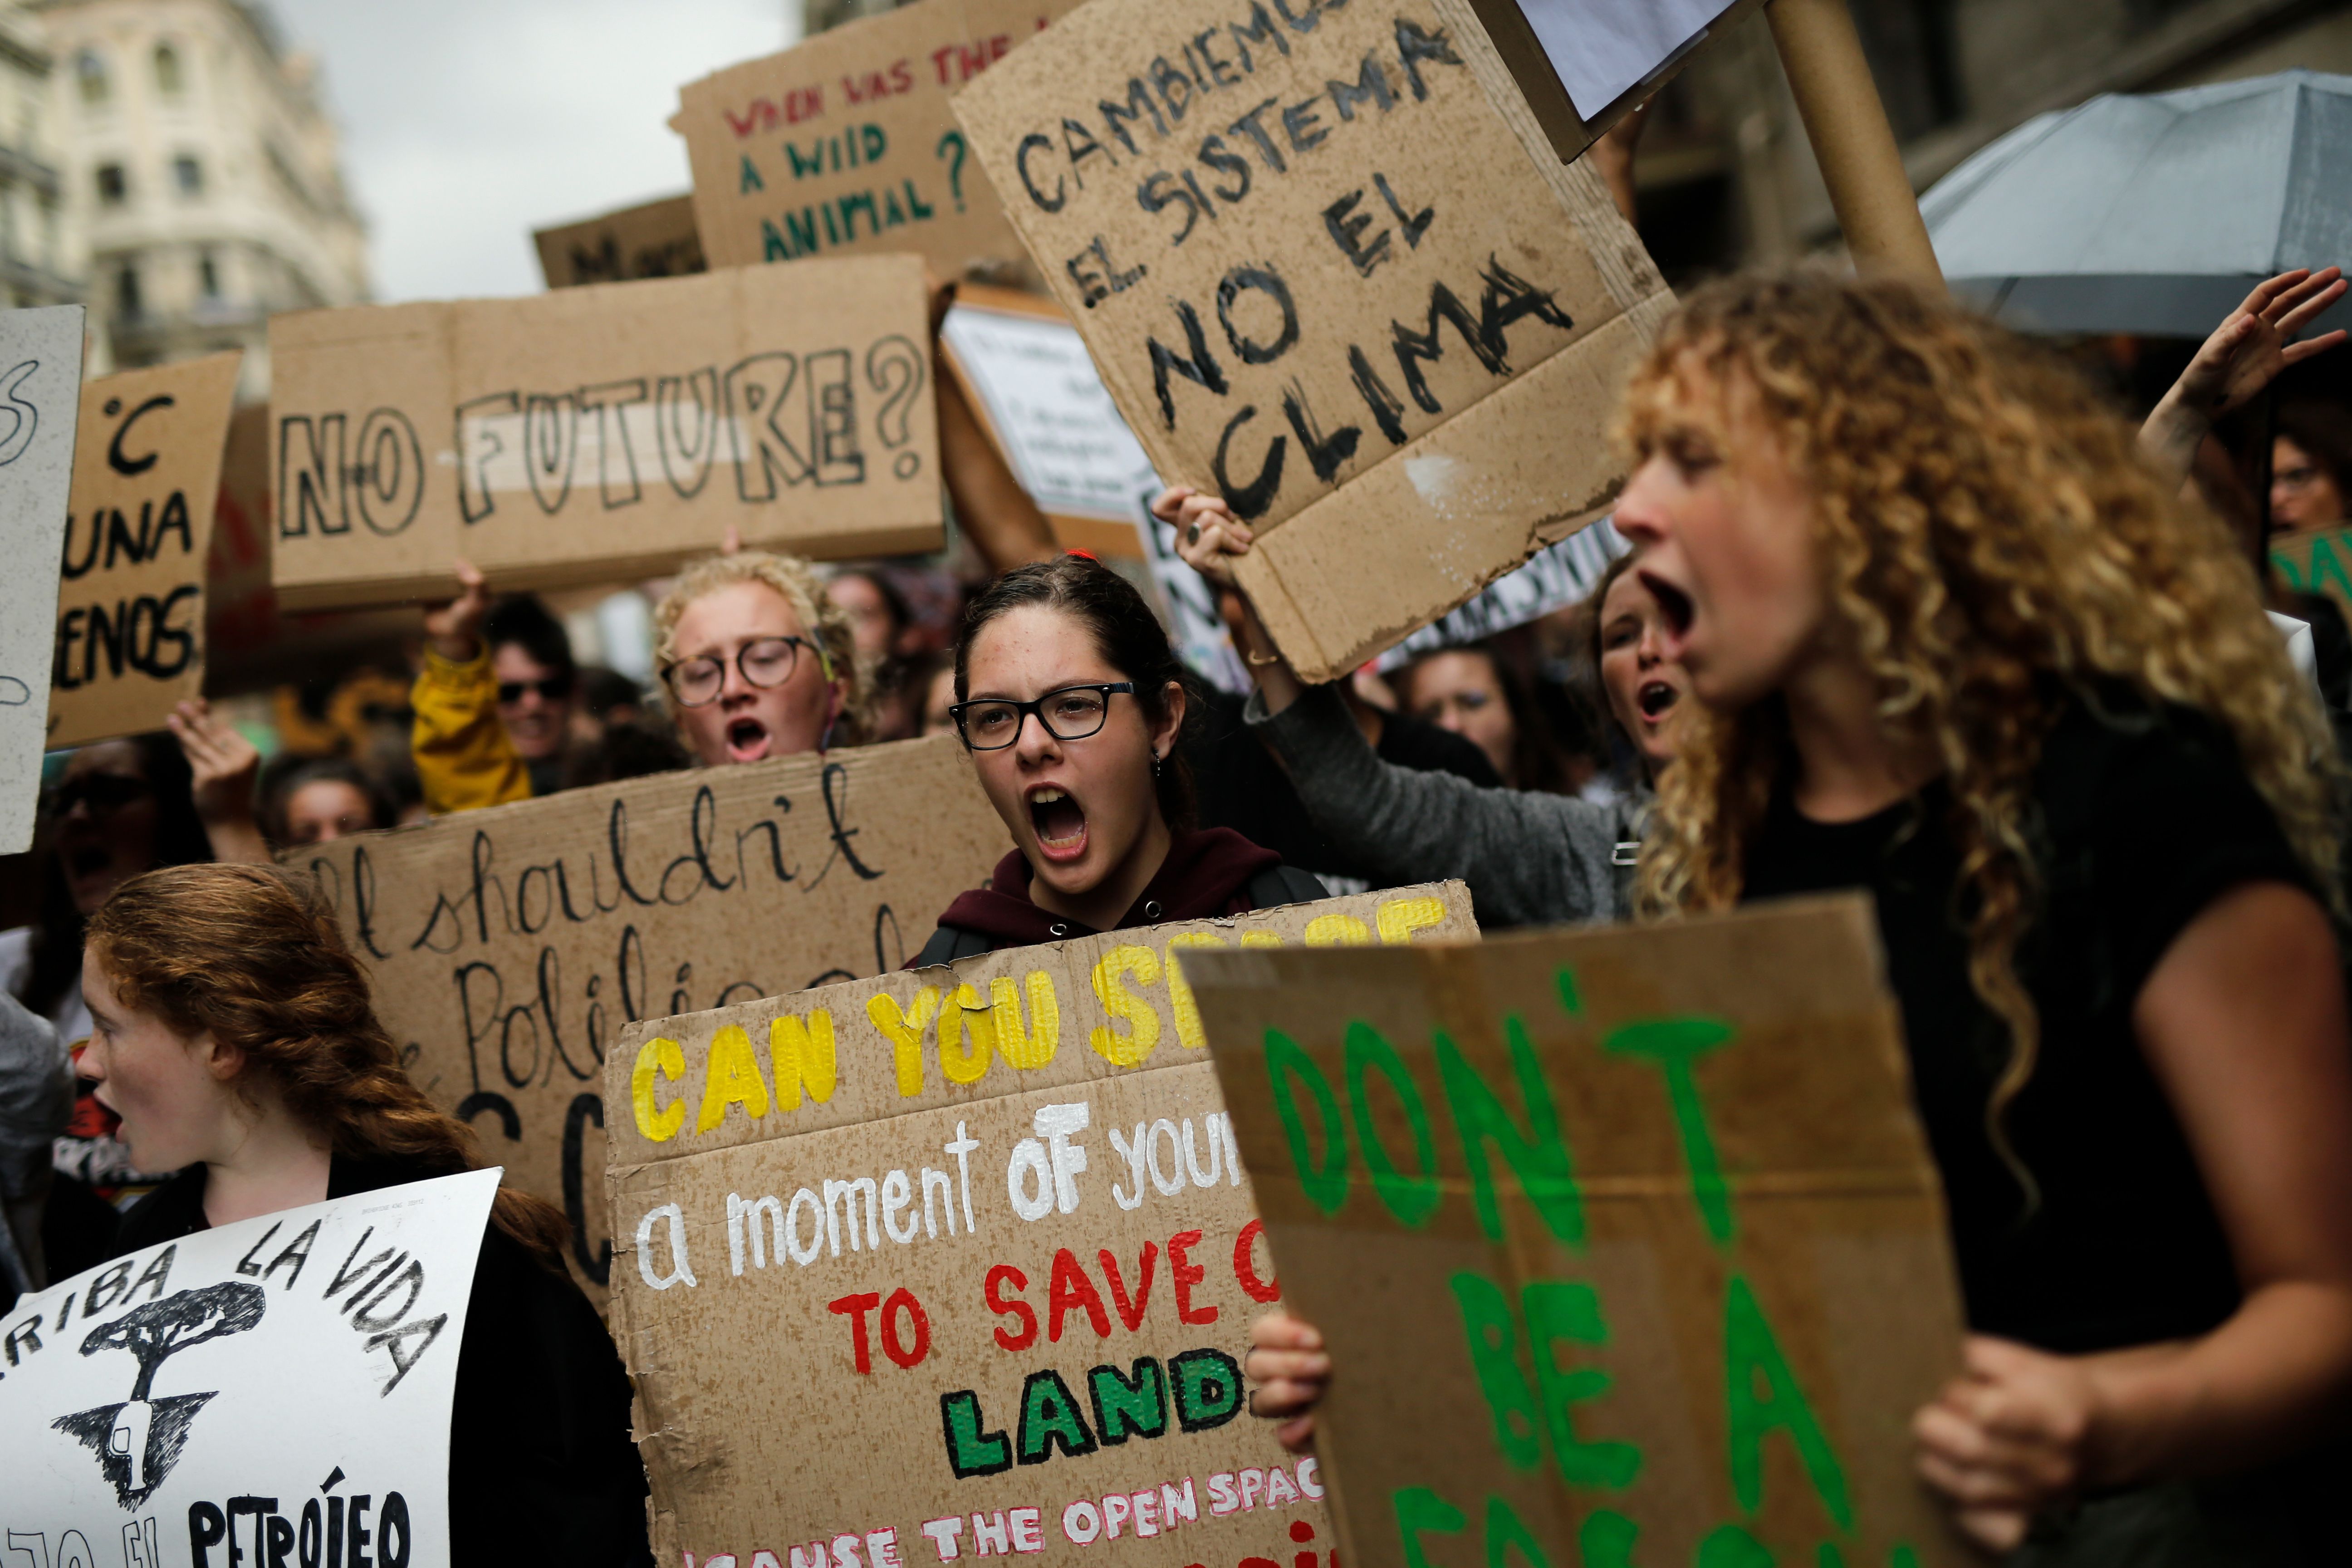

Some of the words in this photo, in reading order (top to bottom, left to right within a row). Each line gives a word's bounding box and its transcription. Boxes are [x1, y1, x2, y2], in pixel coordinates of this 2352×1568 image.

[740, 151, 767, 197] A
[936, 130, 968, 216] ?
[1016, 0, 1354, 214] CAMBIEMO
[1066, 236, 1147, 309] EL
[1138, 18, 1465, 245] SISTEMA
[761, 178, 936, 263] ANIMAL
[1147, 260, 1298, 431] NO
[1323, 172, 1437, 276] EL
[280, 407, 426, 539] NO
[456, 333, 926, 525] FUTURE?
[1212, 252, 1574, 520] CLIMA
[51, 586, 200, 691] ENOS
[412, 764, 886, 952] shouldn't
[632, 1008, 837, 1142] CAN
[866, 970, 1059, 1097] YOU
[1264, 962, 1738, 1251] DON'T
[637, 1202, 696, 1290] a
[727, 1121, 980, 1277] moment
[0, 1243, 178, 1380] RIBA
[322, 1225, 448, 1399] VIDA
[828, 1287, 933, 1375] TO
[984, 1230, 1219, 1352] SAVE
[1449, 1269, 1644, 1491] BE
[1723, 1265, 1859, 1536] A
[920, 1505, 1046, 1563] THE
[1061, 1475, 1201, 1546] OPEN
